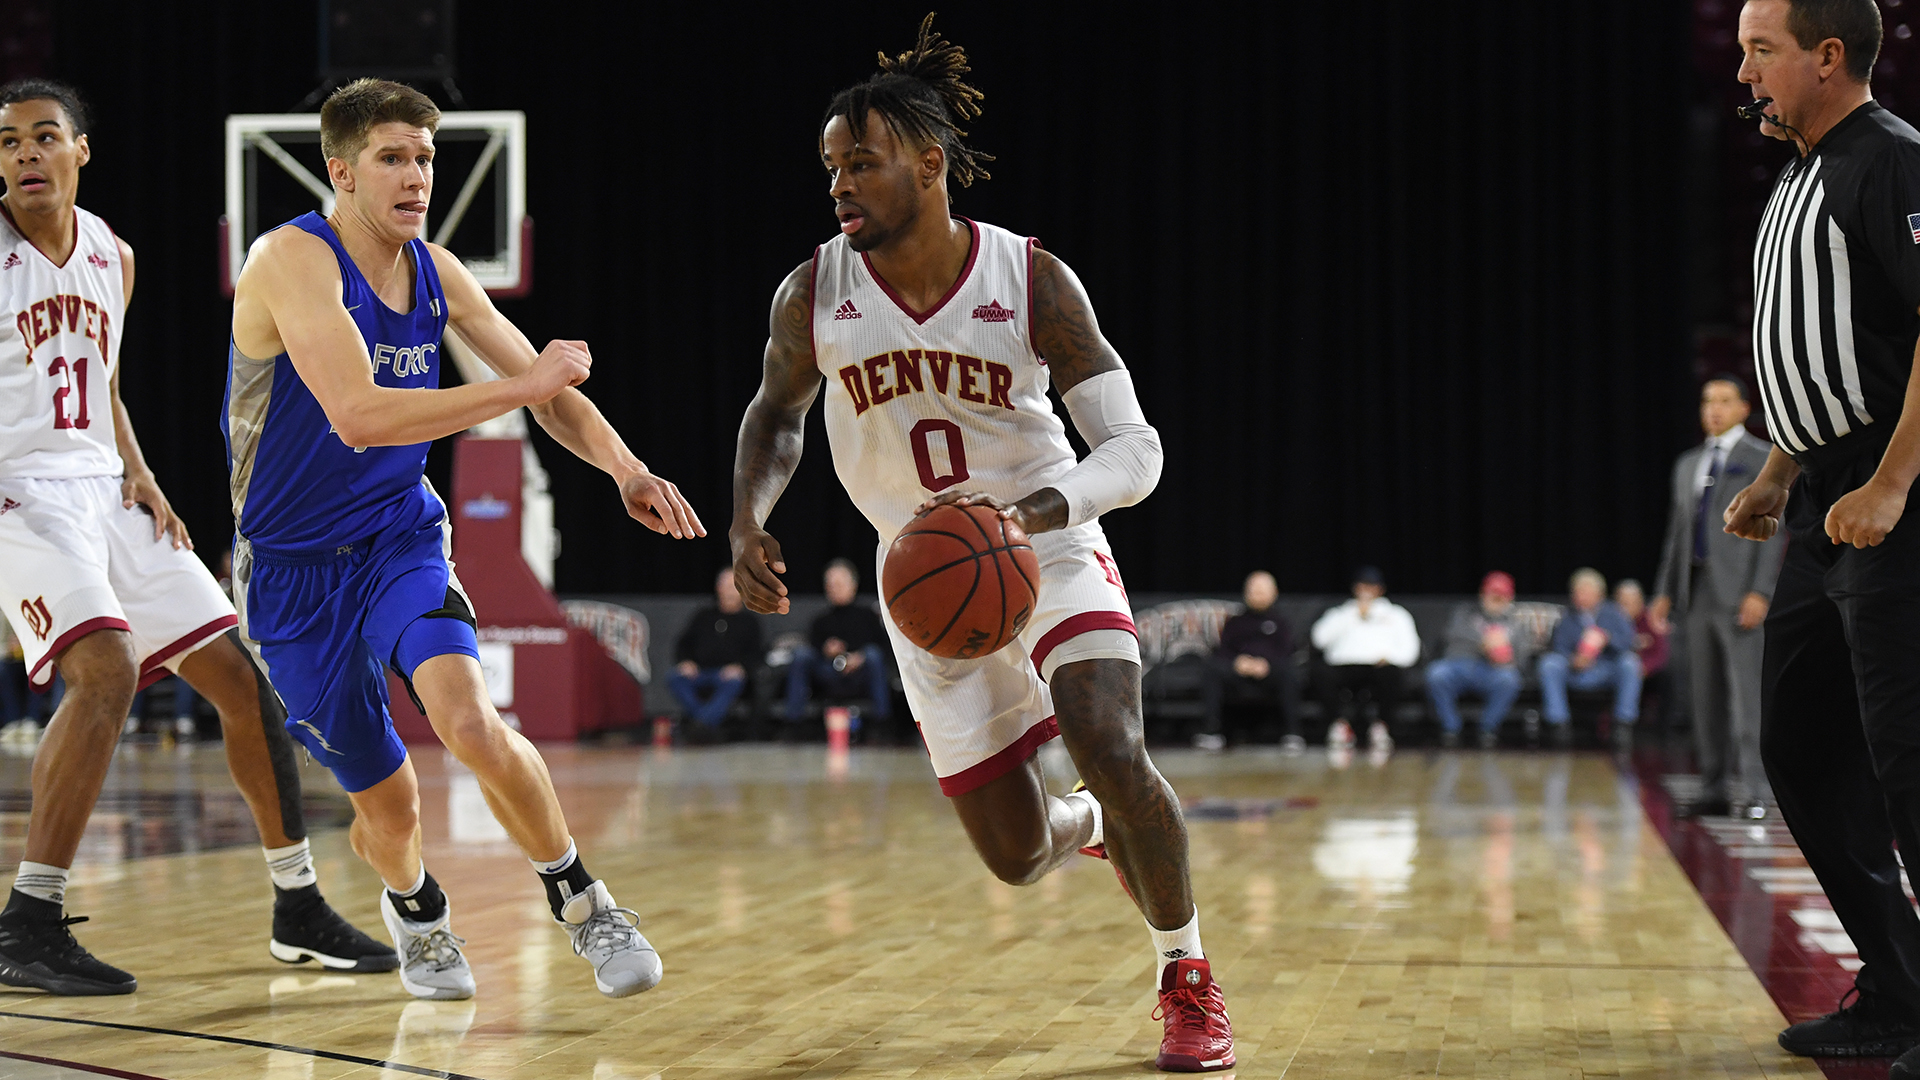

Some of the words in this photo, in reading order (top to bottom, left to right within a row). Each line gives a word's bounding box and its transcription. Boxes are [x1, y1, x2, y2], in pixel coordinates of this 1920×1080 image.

[834, 312, 862, 321] adidas
[971, 308, 1015, 320] SUMMIT
[48, 356, 91, 430] 21
[838, 348, 1016, 419] DENVER
[909, 418, 971, 494] 0
